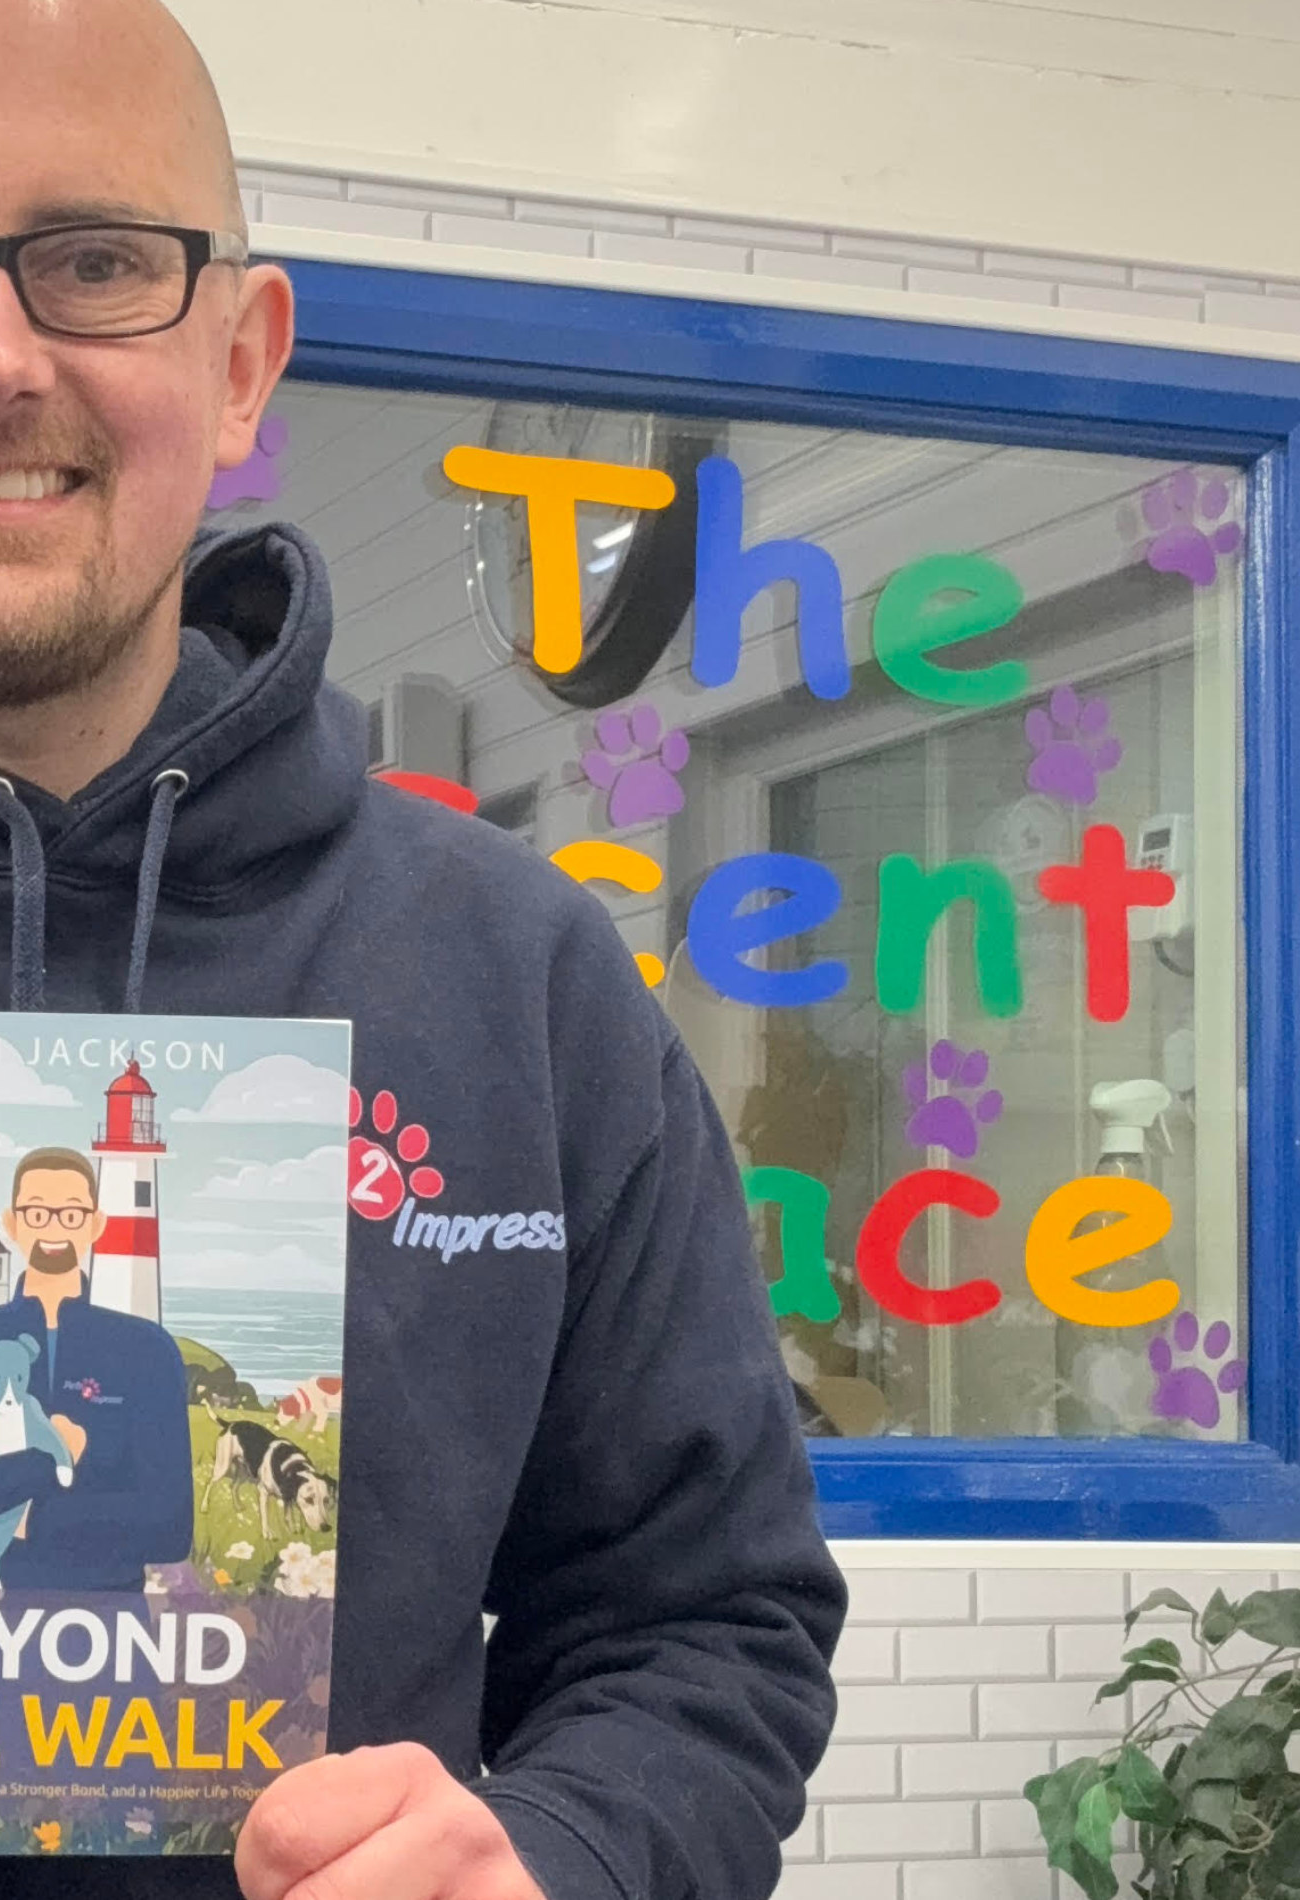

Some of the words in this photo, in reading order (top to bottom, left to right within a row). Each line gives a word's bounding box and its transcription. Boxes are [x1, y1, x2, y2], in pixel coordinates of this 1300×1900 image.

[443, 446, 1029, 704] The
[374, 771, 1176, 1022] ent
[26, 1037, 225, 1071] JACKSON
[350, 1148, 384, 1204] 2
[21, 1694, 285, 1769] WALK
[0, 1785, 7, 1795] a
[10, 1782, 66, 1798] Stronger
[71, 1784, 107, 1798] Bond,
[112, 1784, 135, 1797] and
[139, 1787, 146, 1797] a
[150, 1784, 200, 1800] Happier
[204, 1785, 228, 1798] Life
[231, 1785, 267, 1801] Toge
